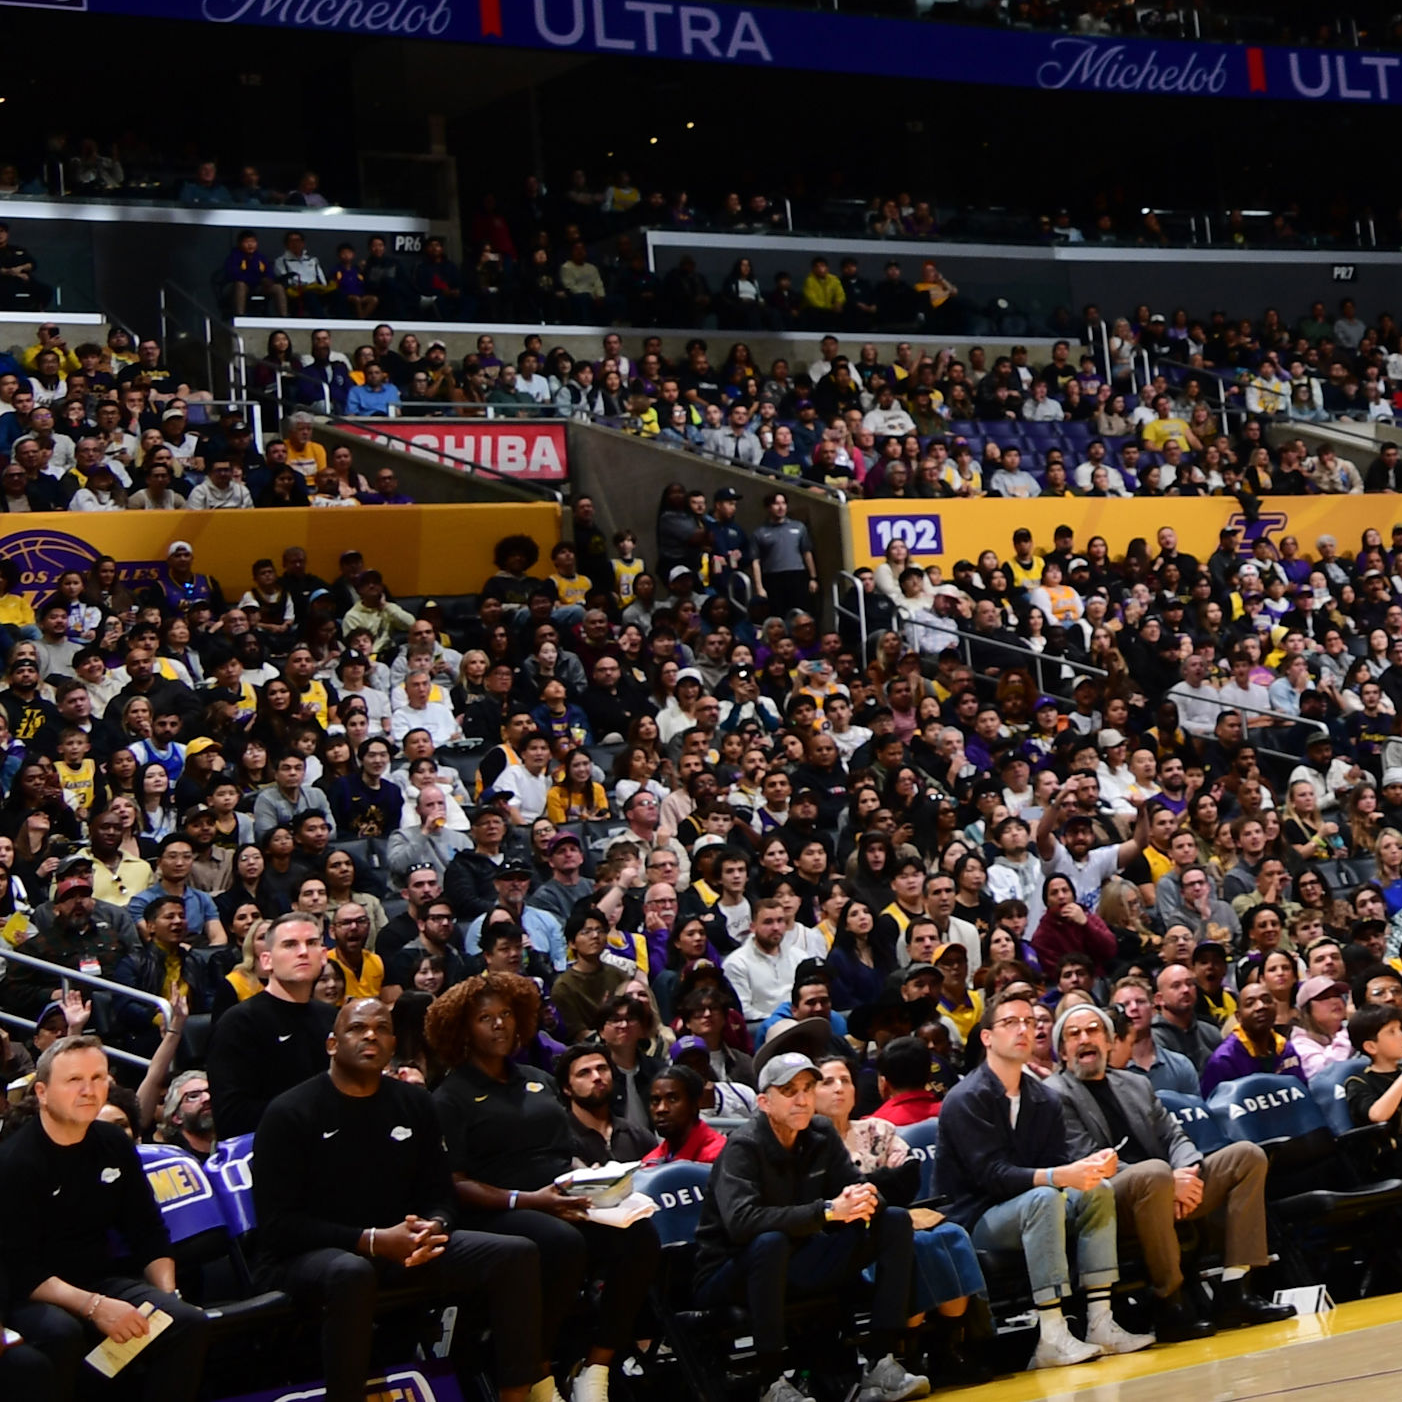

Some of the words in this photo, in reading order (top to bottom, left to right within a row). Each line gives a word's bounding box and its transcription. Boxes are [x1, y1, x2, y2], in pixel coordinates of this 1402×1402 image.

[1036, 38, 1228, 95] Michelob
[394, 234, 422, 252] PR6
[876, 519, 938, 552] 102
[1243, 1086, 1305, 1114] DELTA
